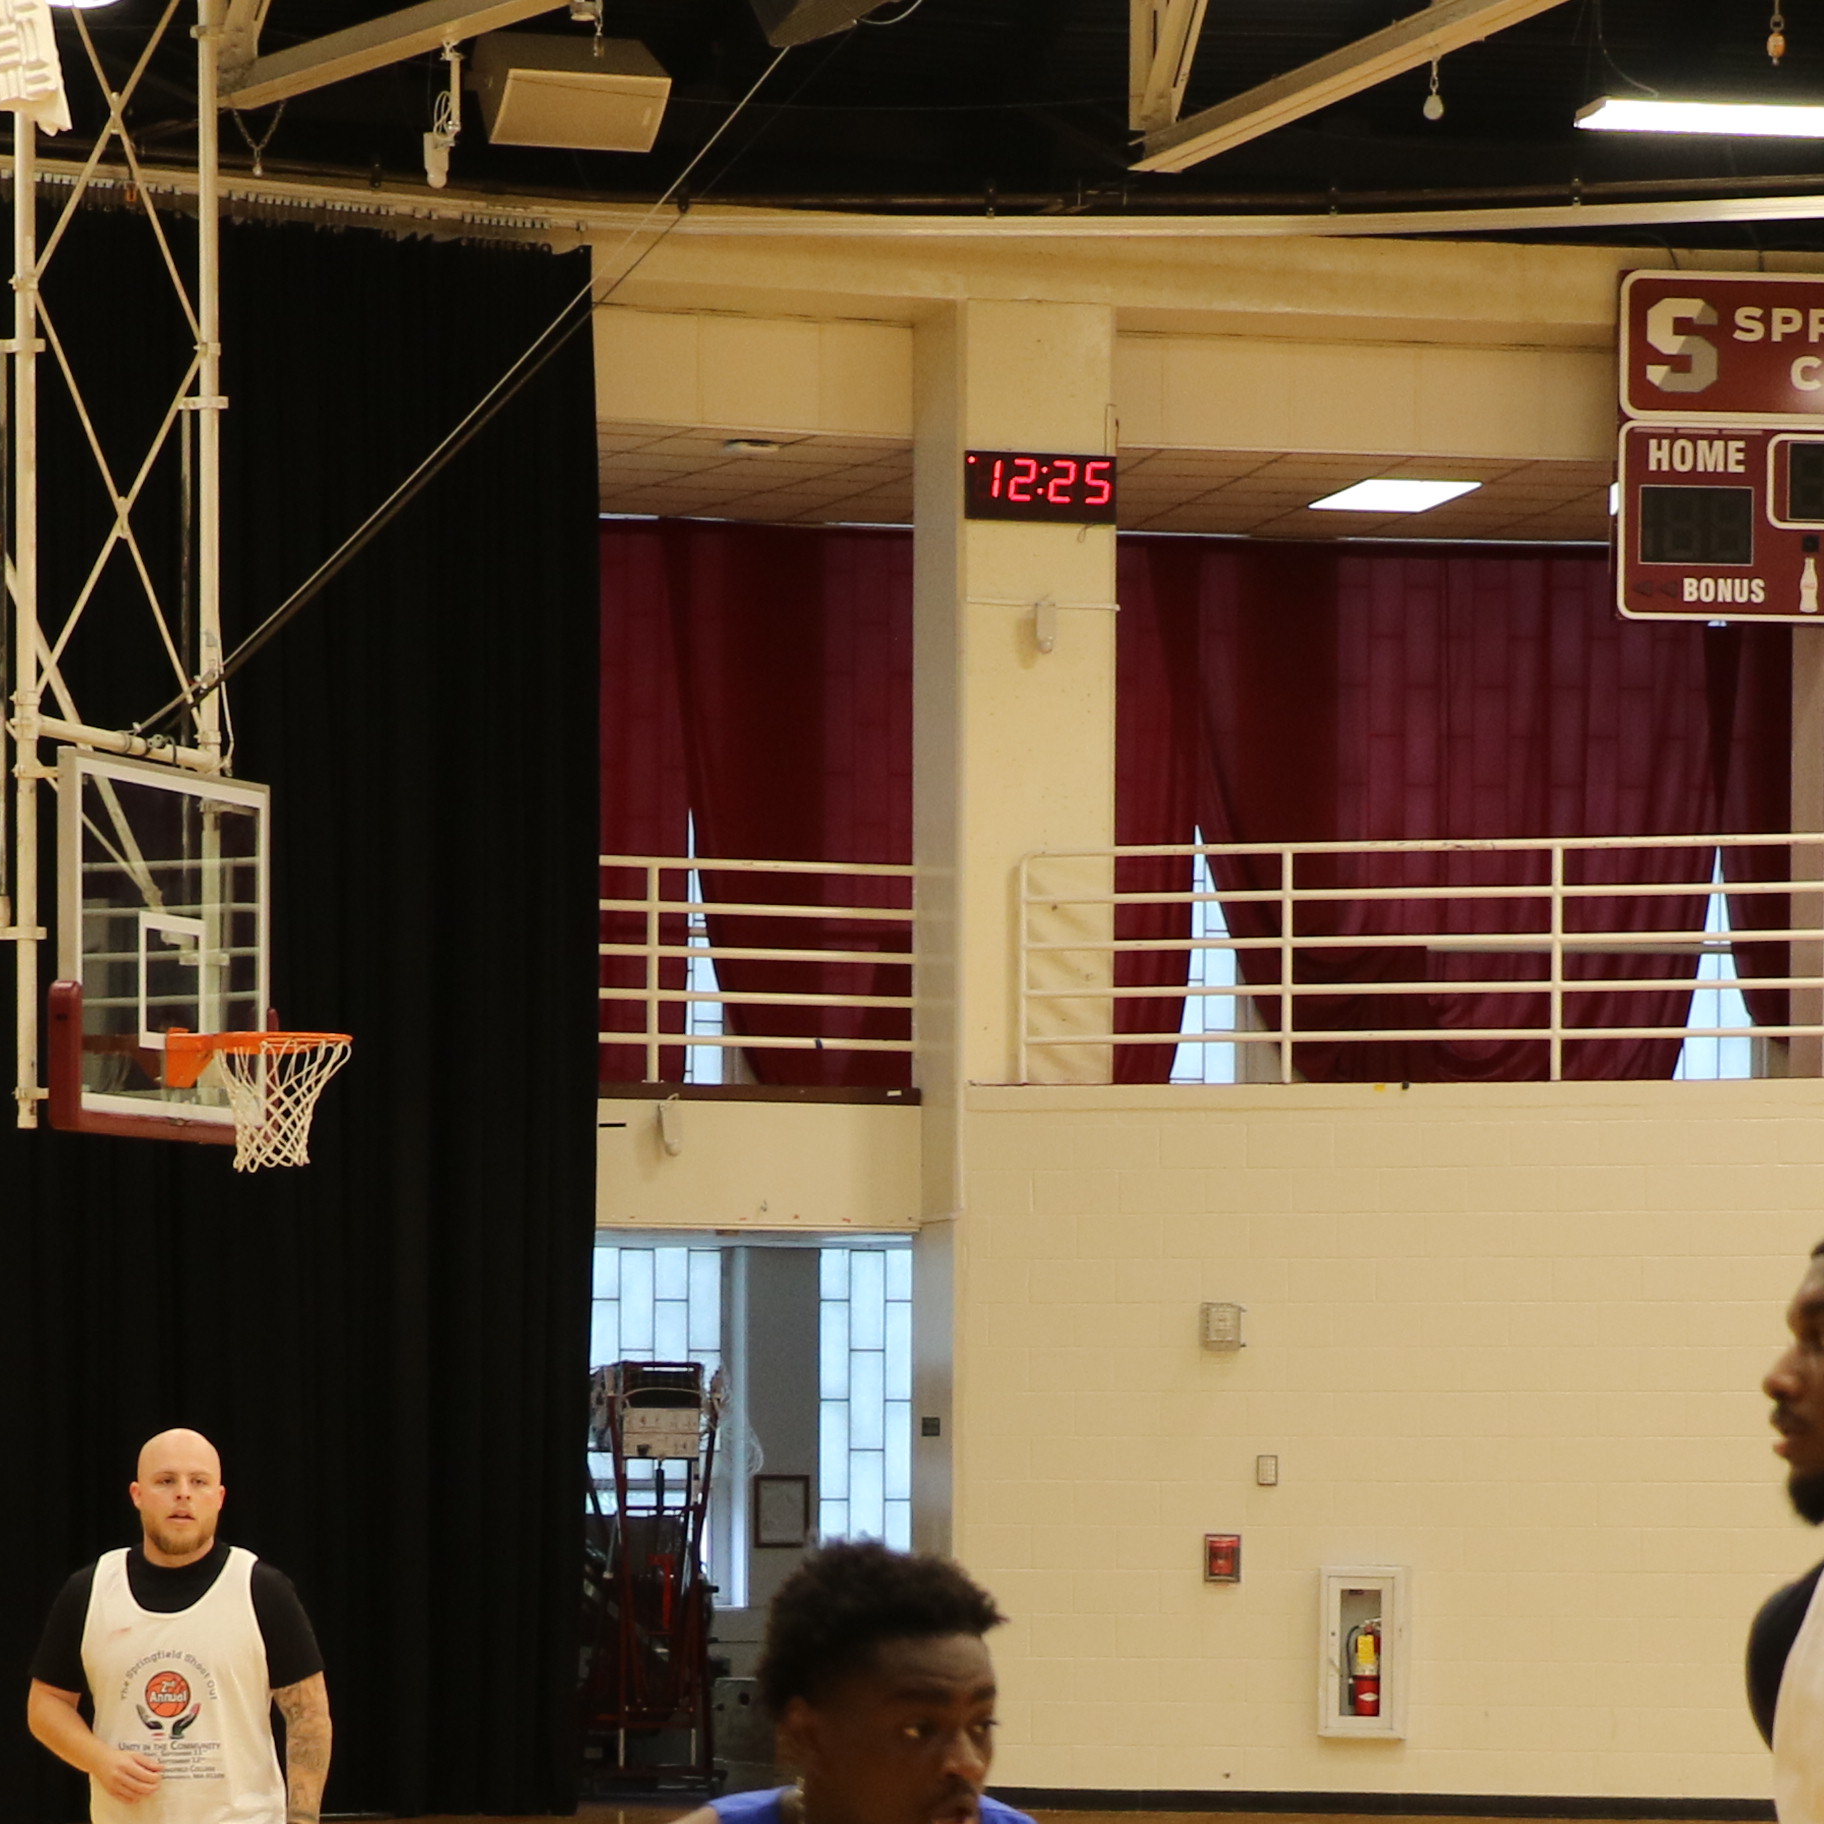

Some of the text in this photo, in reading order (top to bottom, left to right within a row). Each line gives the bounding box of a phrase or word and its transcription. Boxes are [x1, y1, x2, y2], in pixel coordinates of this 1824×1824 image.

[1648, 438, 1746, 473] HOME
[991, 458, 1112, 504] 12:25
[1683, 577, 1765, 603] BONUS
[125, 1650, 183, 1679] Springfield
[149, 1690, 187, 1703] Annual
